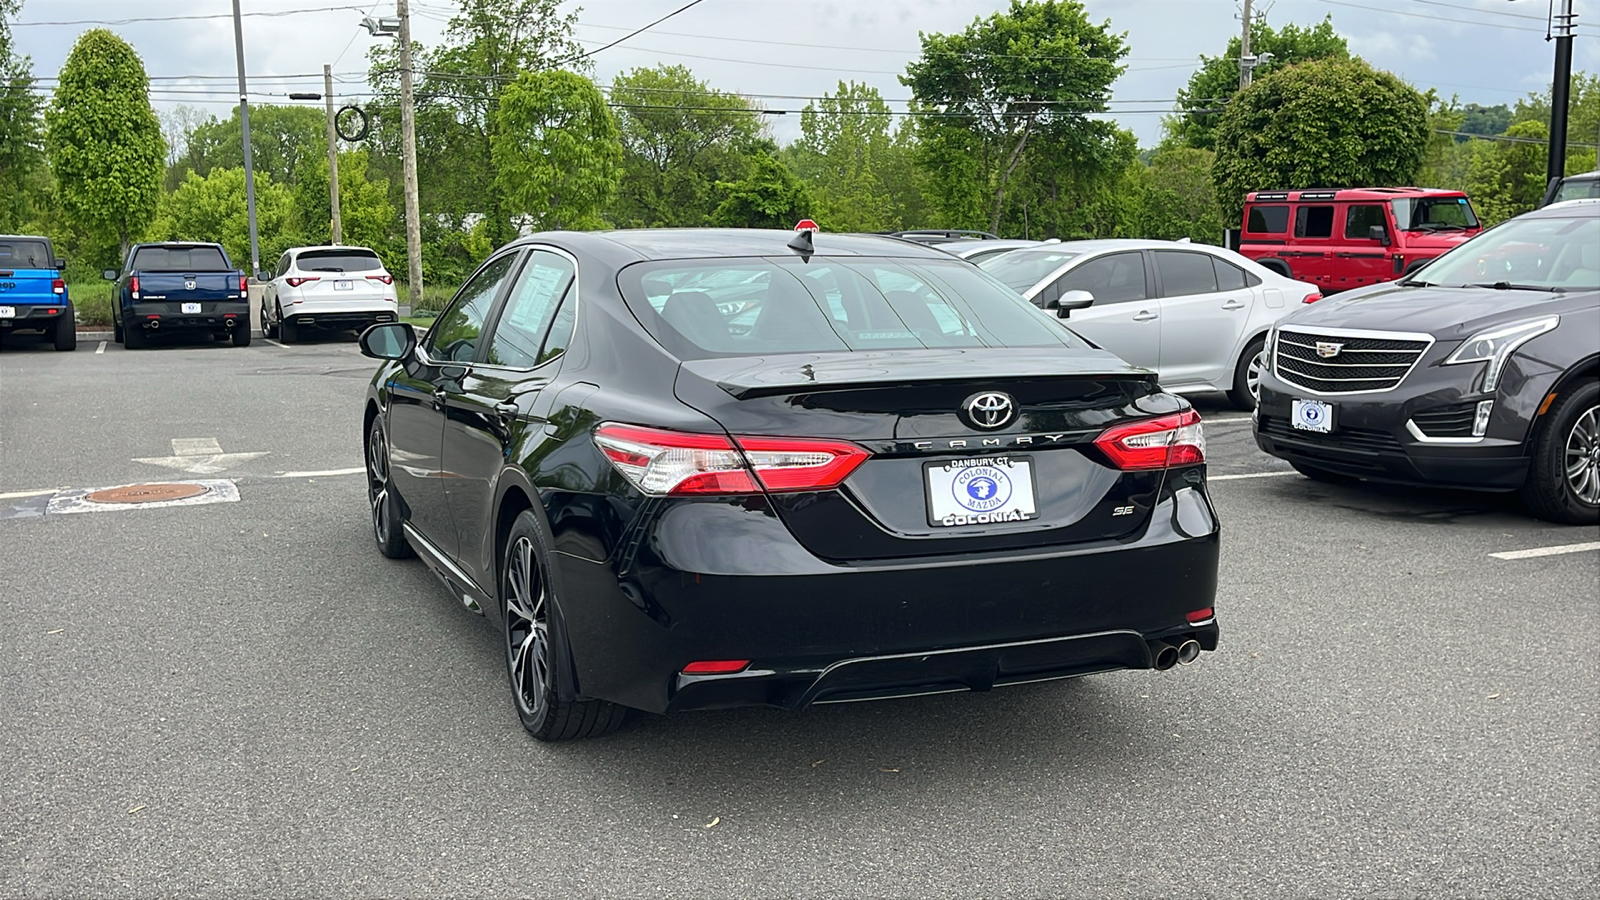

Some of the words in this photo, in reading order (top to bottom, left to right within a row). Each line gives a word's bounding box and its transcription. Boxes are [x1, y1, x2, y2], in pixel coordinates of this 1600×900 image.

[914, 435, 1064, 449] CAMRY
[996, 457, 1009, 466] CT
[958, 468, 1004, 485] COLONIAL
[967, 496, 1002, 509] MAZDA
[1113, 506, 1134, 516] SE
[942, 512, 1030, 526] COLONIAL
